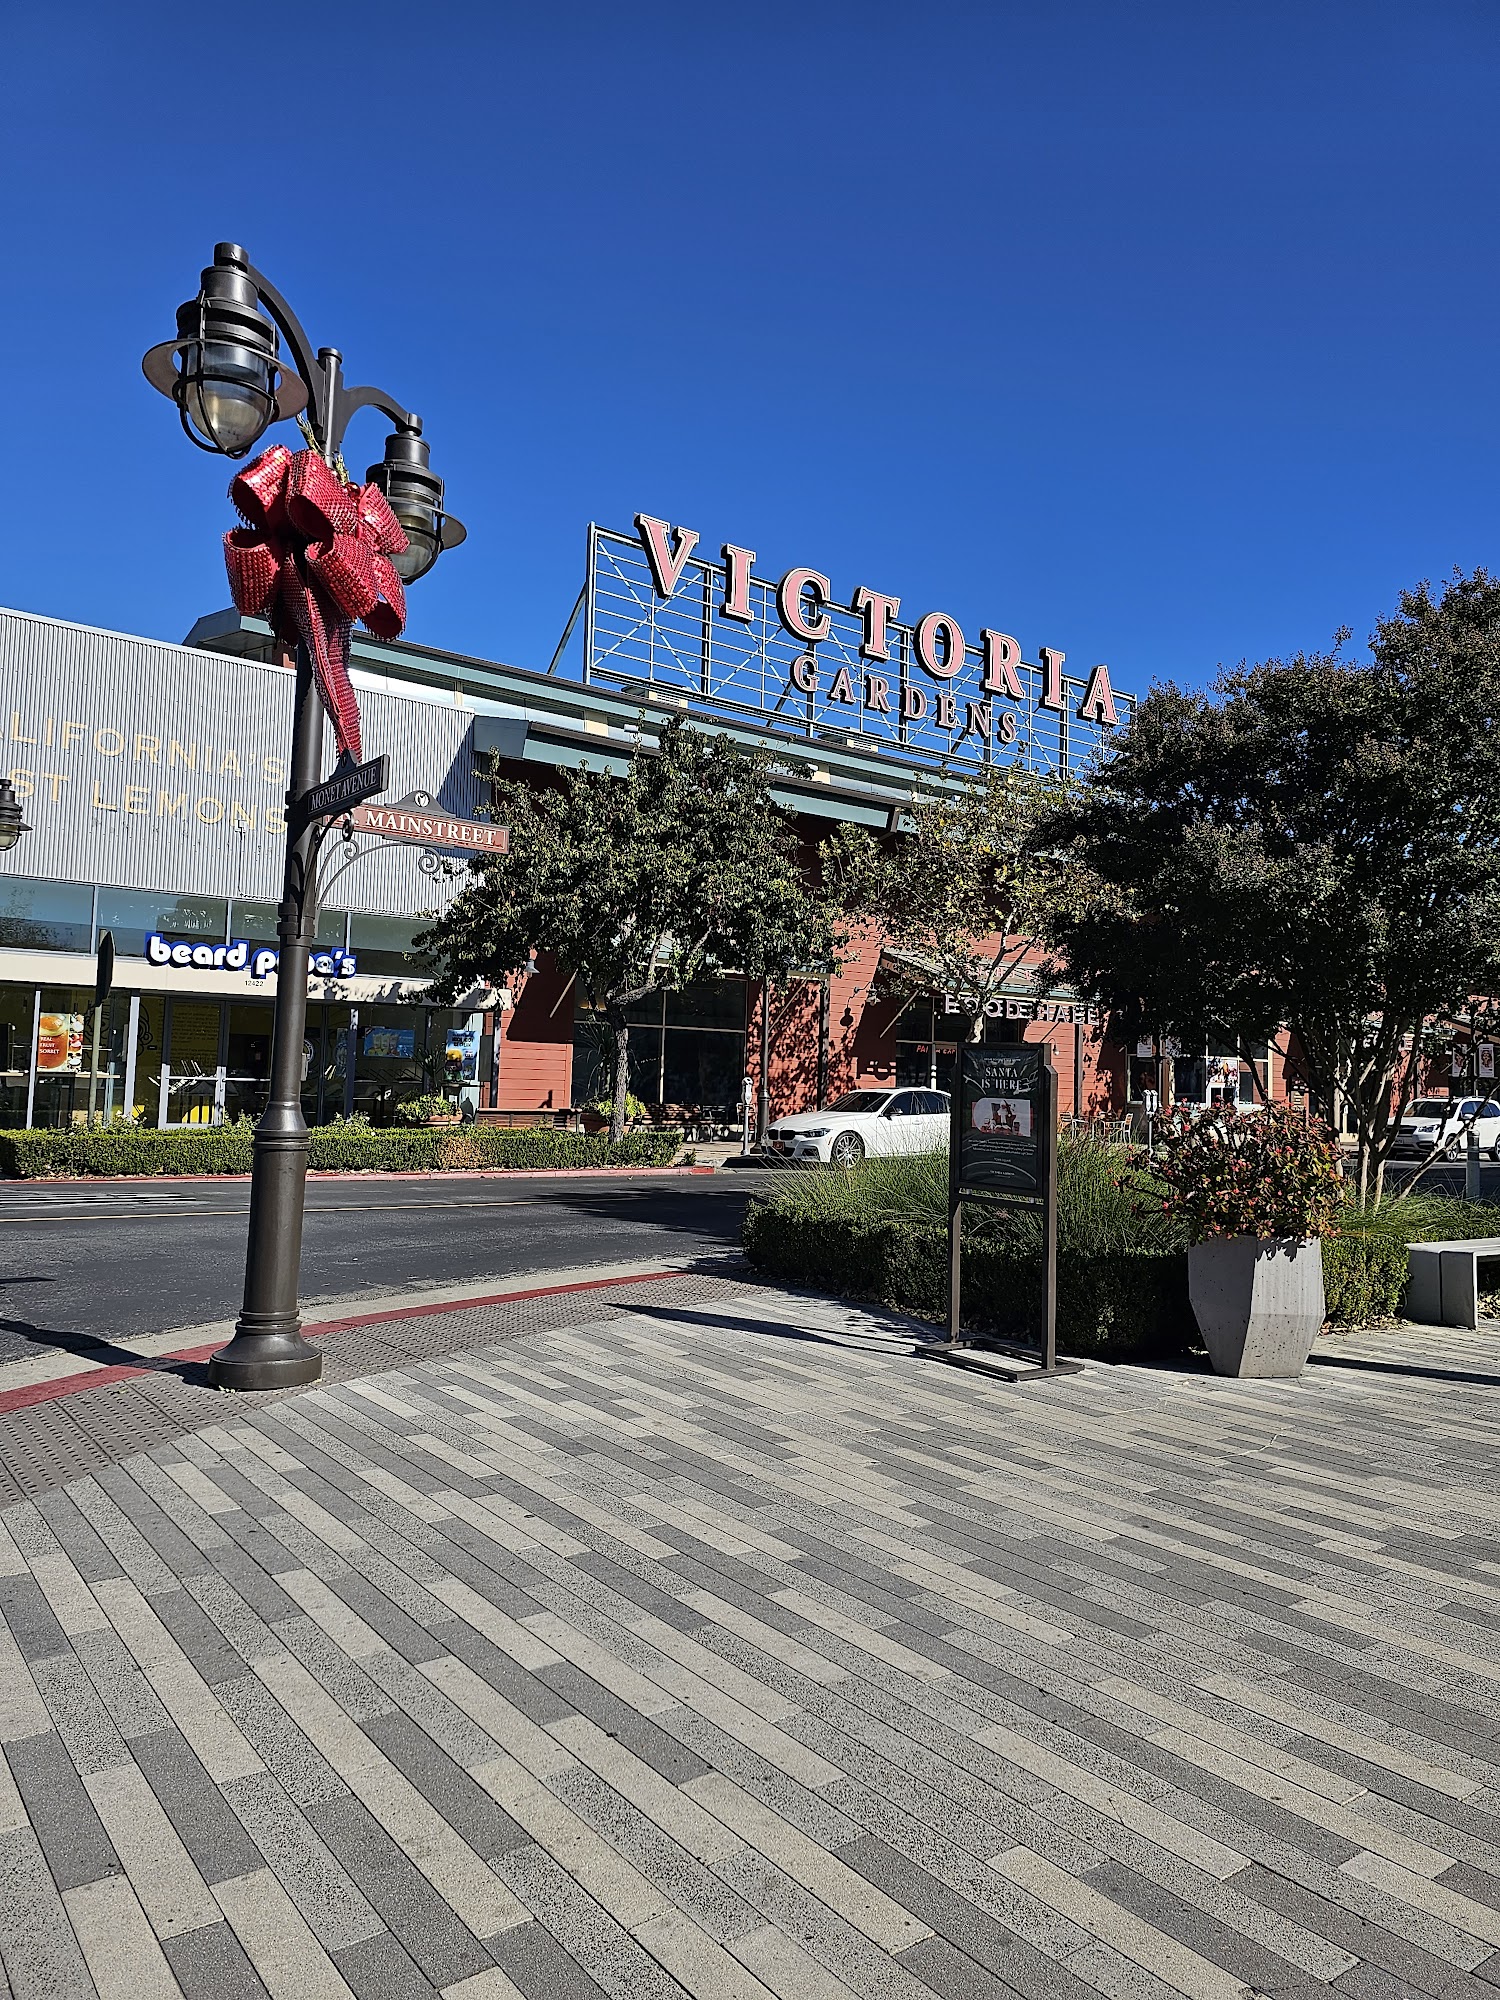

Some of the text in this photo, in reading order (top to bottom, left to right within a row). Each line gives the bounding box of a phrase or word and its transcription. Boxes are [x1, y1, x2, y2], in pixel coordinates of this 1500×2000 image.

[634, 512, 1119, 725] VICTORIA
[790, 655, 1016, 744] GARDENS
[0, 711, 286, 785] LIFORNIA'S
[92, 780, 288, 834] LEMONS
[149, 934, 248, 969] beard
[945, 994, 1100, 1026] FOOD HALL
[981, 1078, 1023, 1090] IS HERE
[985, 1067, 1018, 1078] SANTA
